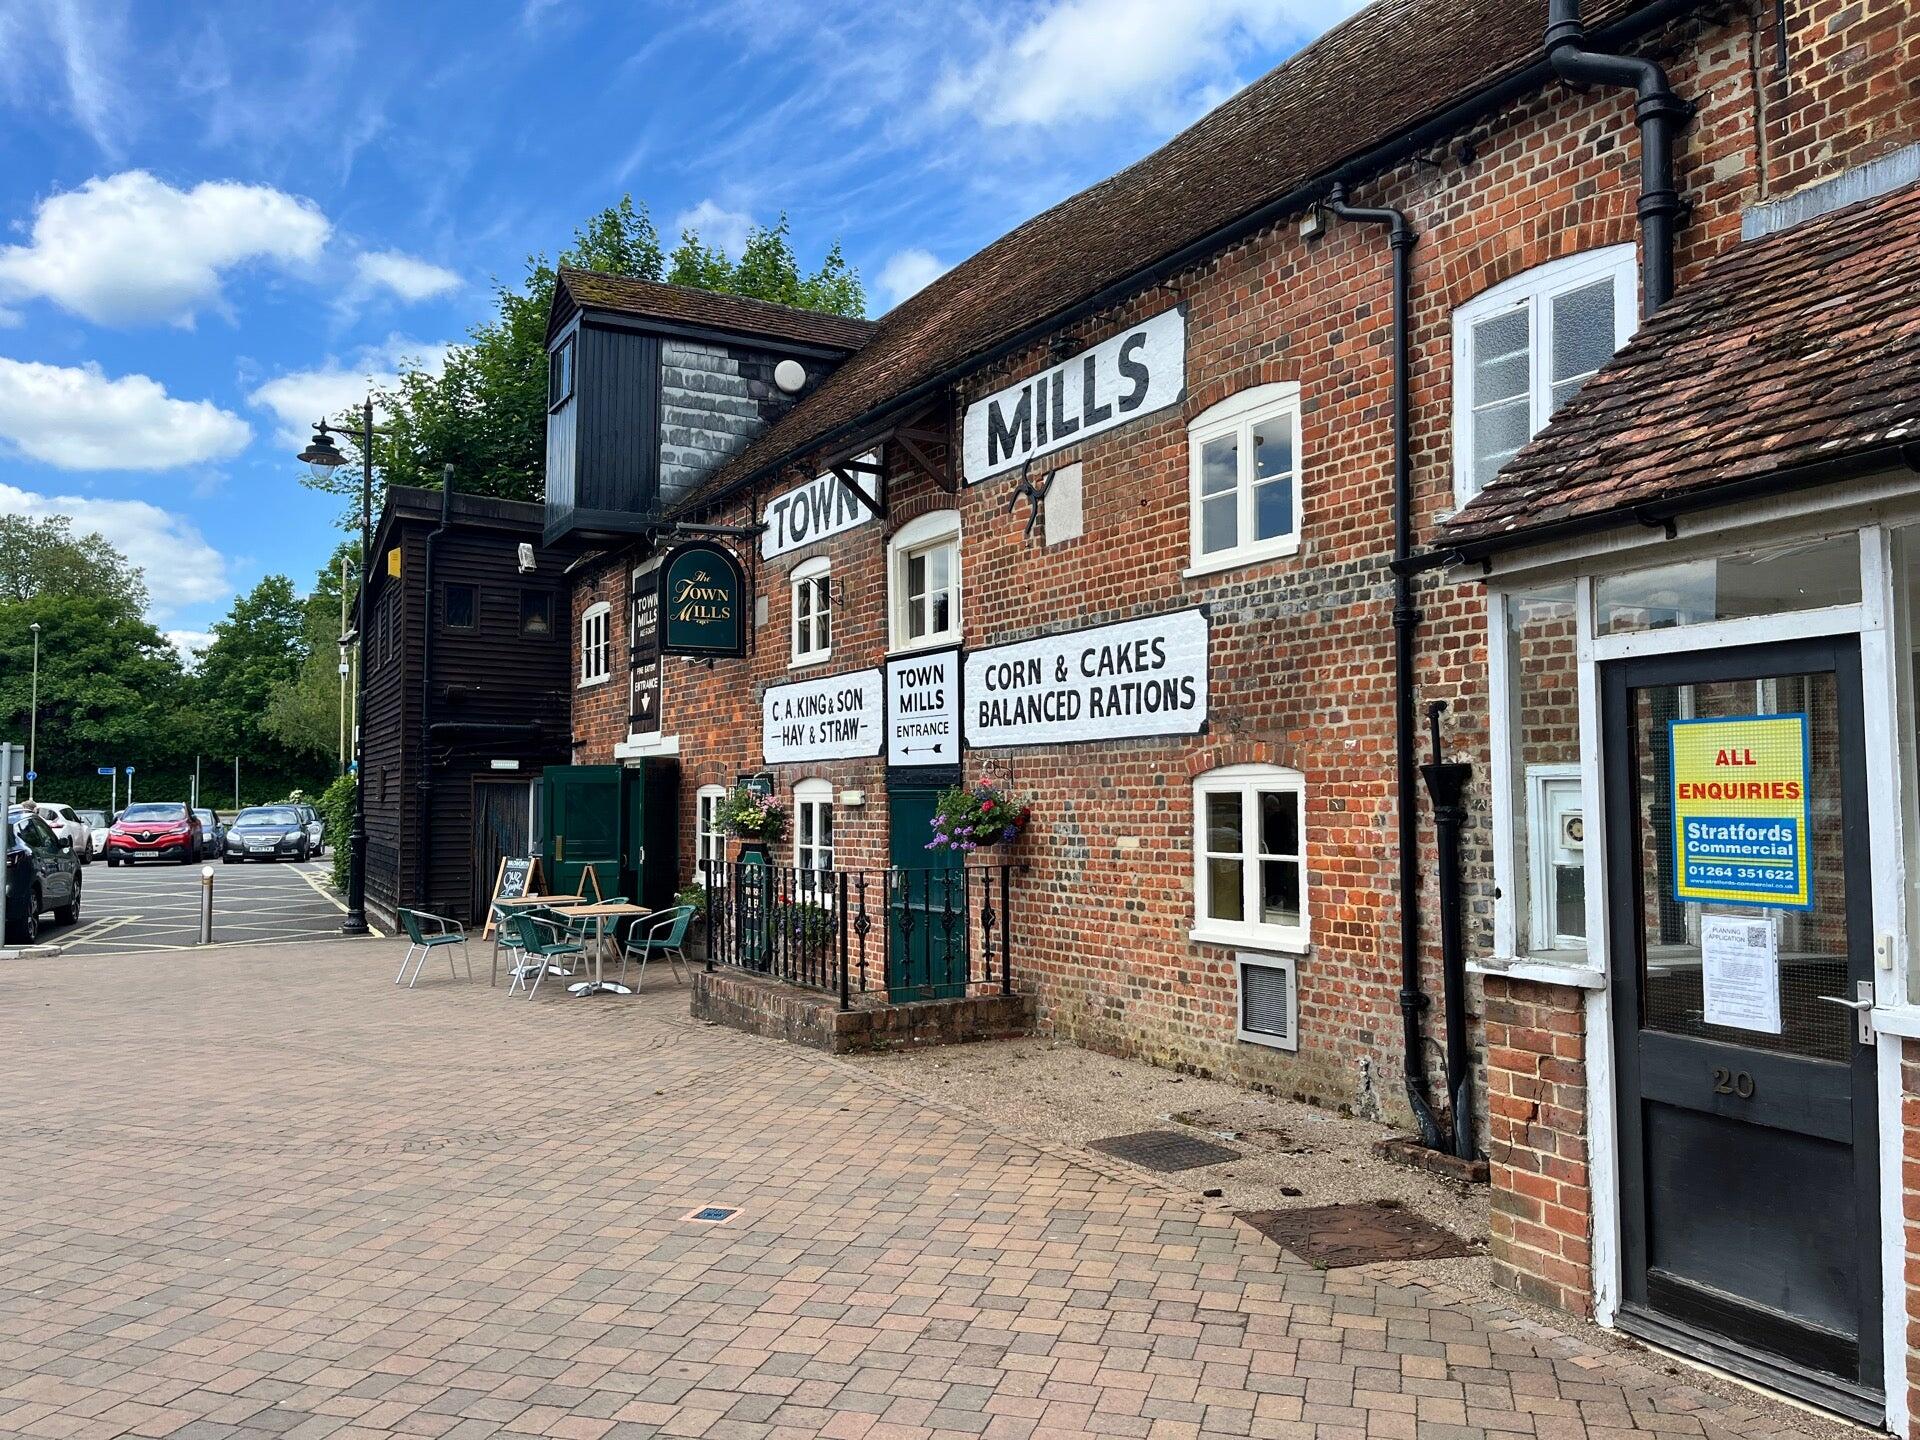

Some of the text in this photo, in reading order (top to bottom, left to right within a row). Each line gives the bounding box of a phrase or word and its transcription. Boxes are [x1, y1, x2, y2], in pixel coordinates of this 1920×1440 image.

[987, 331, 1150, 467] MILLS
[773, 470, 859, 549] TOWN
[694, 571, 711, 583] The
[638, 593, 658, 611] TOWN
[638, 609, 657, 627] MILLS
[985, 636, 1166, 691] CORN & CAKES
[635, 678, 658, 692] ENTRANCE
[897, 663, 944, 689] TOWN
[837, 687, 863, 713] SON
[900, 688, 944, 713] MILLS
[979, 675, 1196, 728] BALANCED RATIONS
[809, 725, 816, 744] &
[896, 721, 949, 738] ENTRANCE
[1715, 748, 1757, 766] ALL
[1678, 781, 1800, 800] ENQUIRIES
[1687, 822, 1793, 842] Stratfords
[1687, 840, 1793, 856] Commercial
[1688, 865, 1795, 881] 01264 351622
[1708, 934, 1746, 943] APPLICATION
[1712, 926, 1742, 936] PLANNING
[1711, 1066, 1754, 1099] 20
